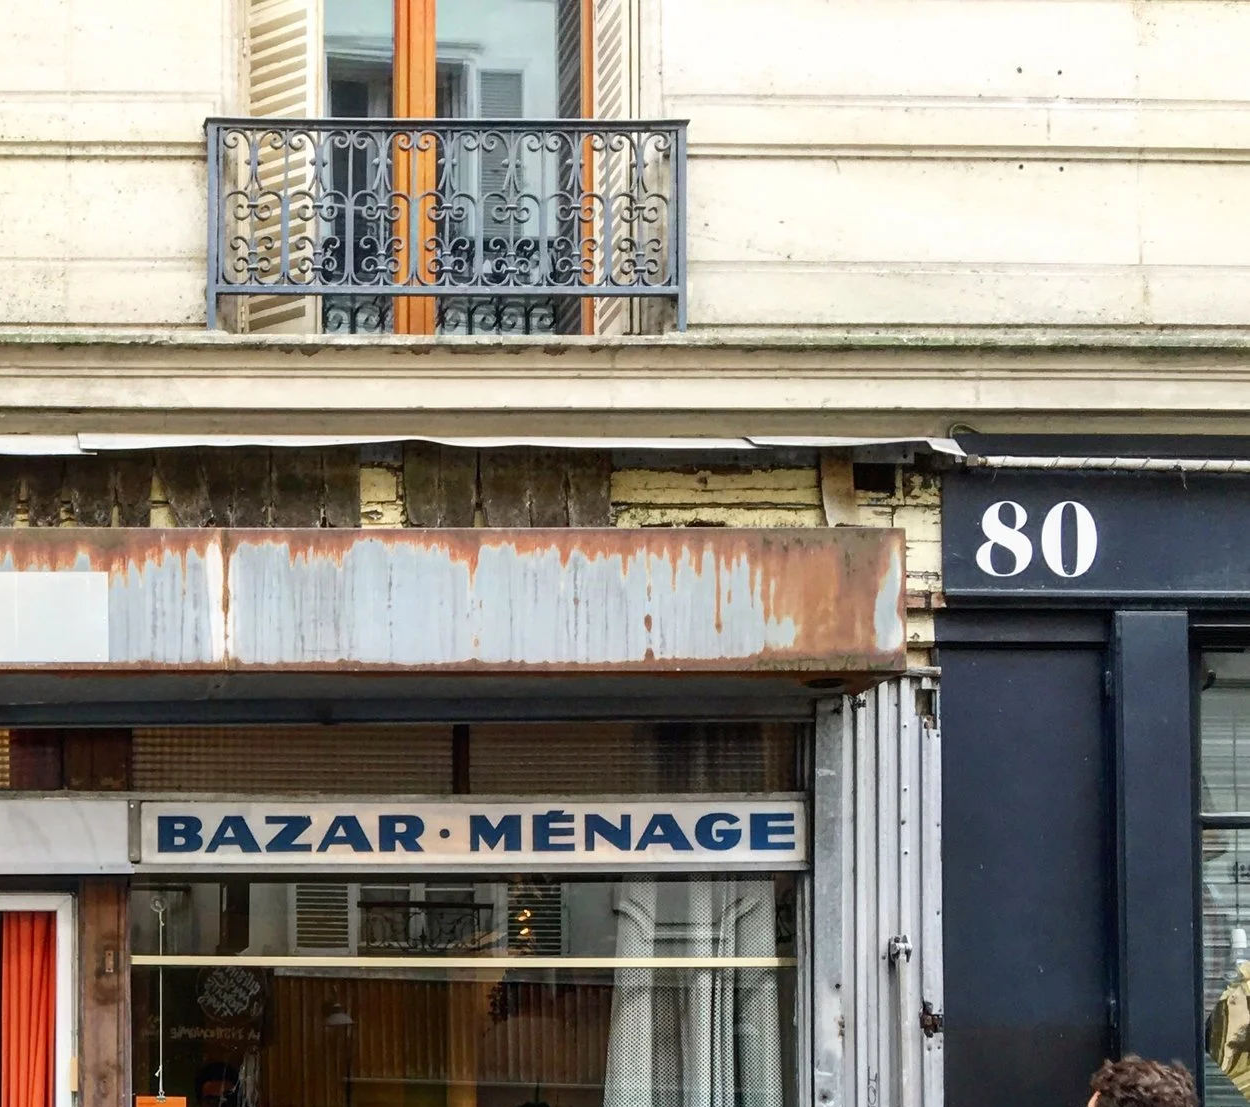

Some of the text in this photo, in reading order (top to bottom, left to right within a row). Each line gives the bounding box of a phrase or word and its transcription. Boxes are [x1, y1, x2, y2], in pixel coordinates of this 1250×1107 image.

[976, 501, 1098, 577] 80
[157, 810, 795, 852] BAZAR MÉNAGE
